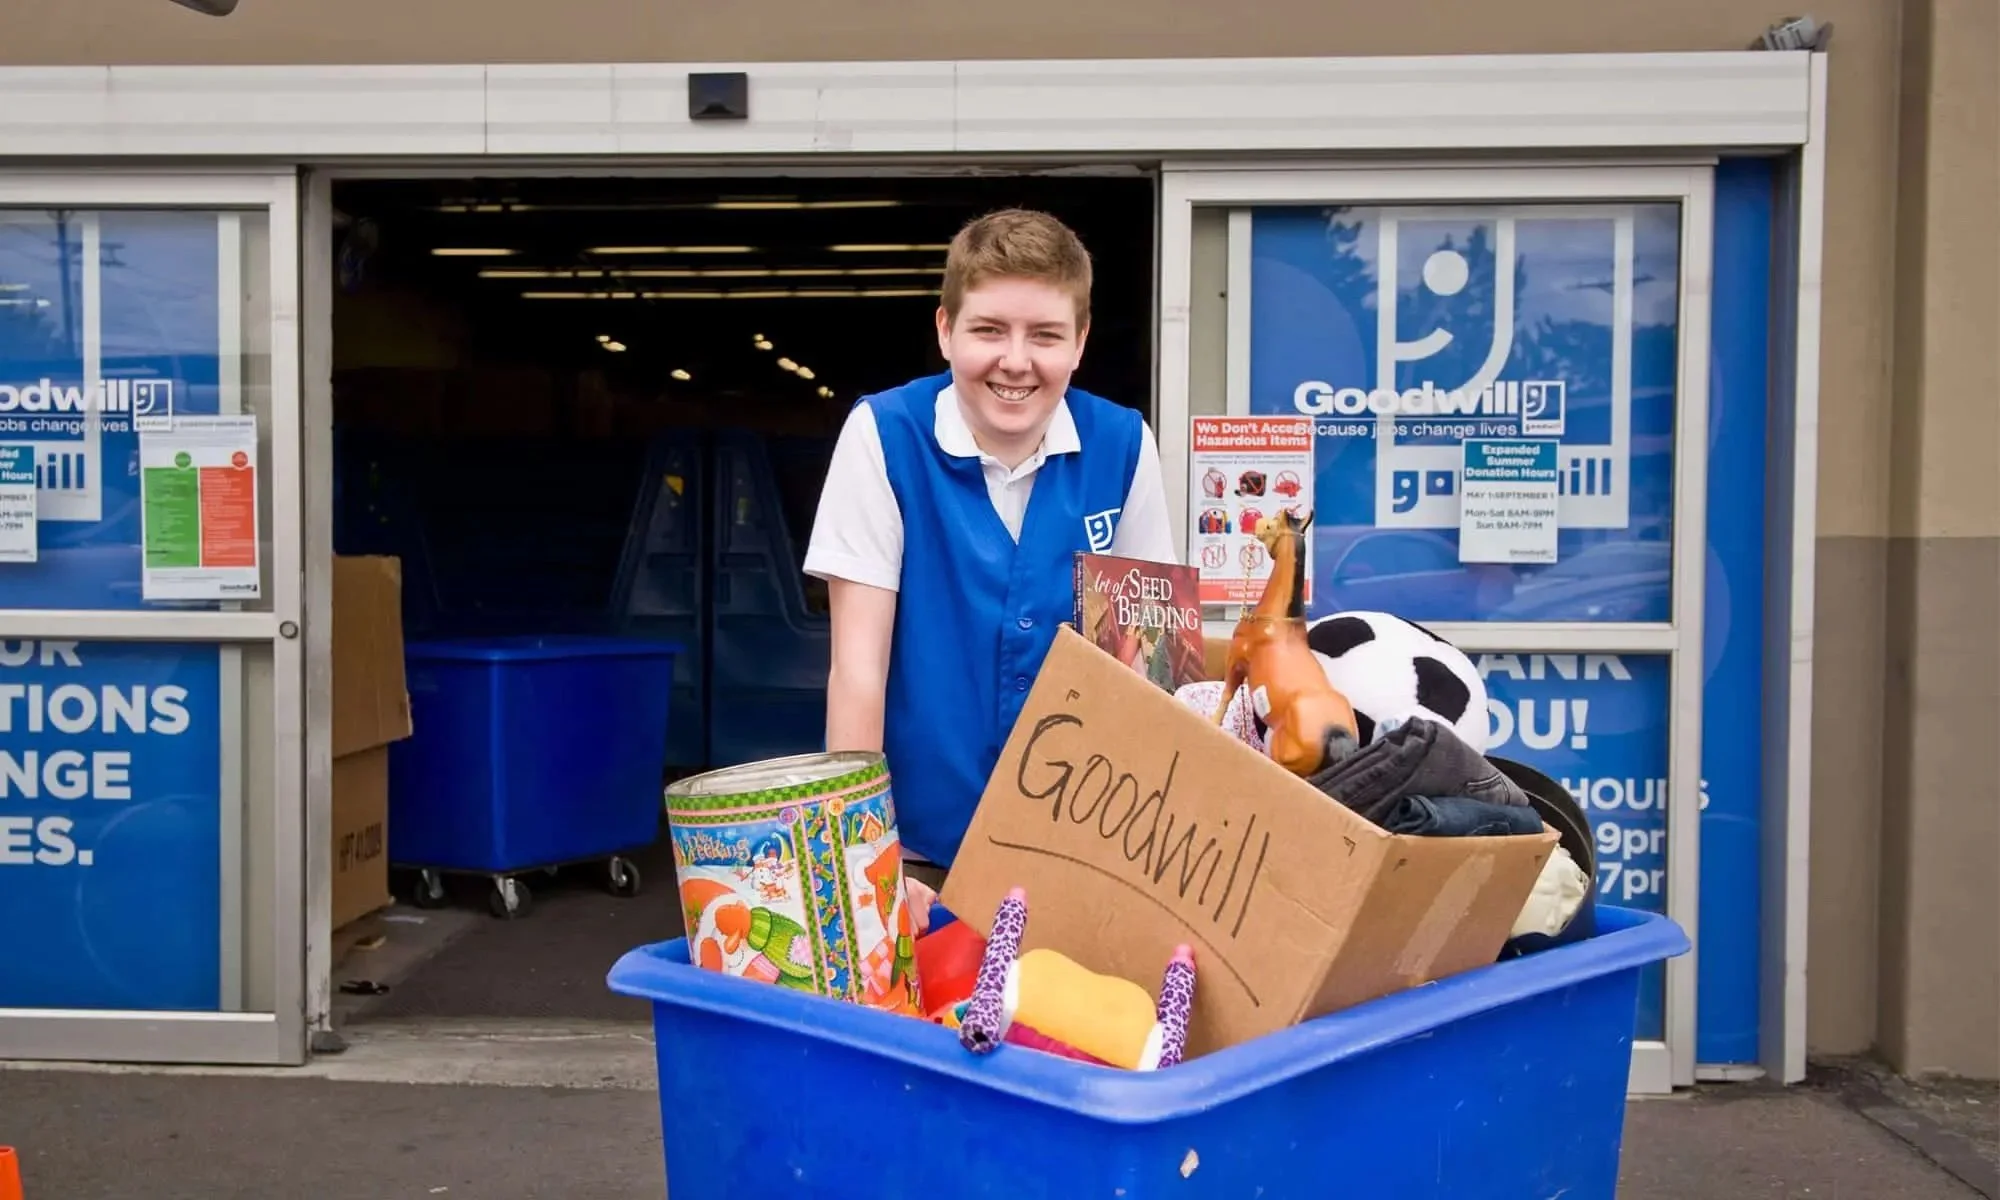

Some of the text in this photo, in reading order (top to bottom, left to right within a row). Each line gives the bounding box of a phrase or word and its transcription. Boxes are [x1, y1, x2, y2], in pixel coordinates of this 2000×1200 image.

[1293, 380, 1518, 415] Goodwill
[1196, 422, 1218, 433] We
[1222, 422, 1258, 433] Don't
[1412, 421, 1476, 439] change
[1480, 421, 1517, 436] lives
[1196, 435, 1308, 447] Hazardous Items
[1482, 444, 1541, 456] Expanded
[1486, 456, 1536, 466] Summer
[1466, 467, 1555, 478] Donation Hours
[1465, 508, 1505, 517] Mon-Sat
[1475, 521, 1494, 530] Sun
[1087, 570, 1112, 594] Art
[1110, 573, 1130, 602] of
[1128, 568, 1173, 601] SEED
[1118, 595, 1199, 630] BEADING
[0, 750, 132, 800] NGE
[1016, 713, 1270, 939] Goodwill
[0, 815, 94, 866] ES.
